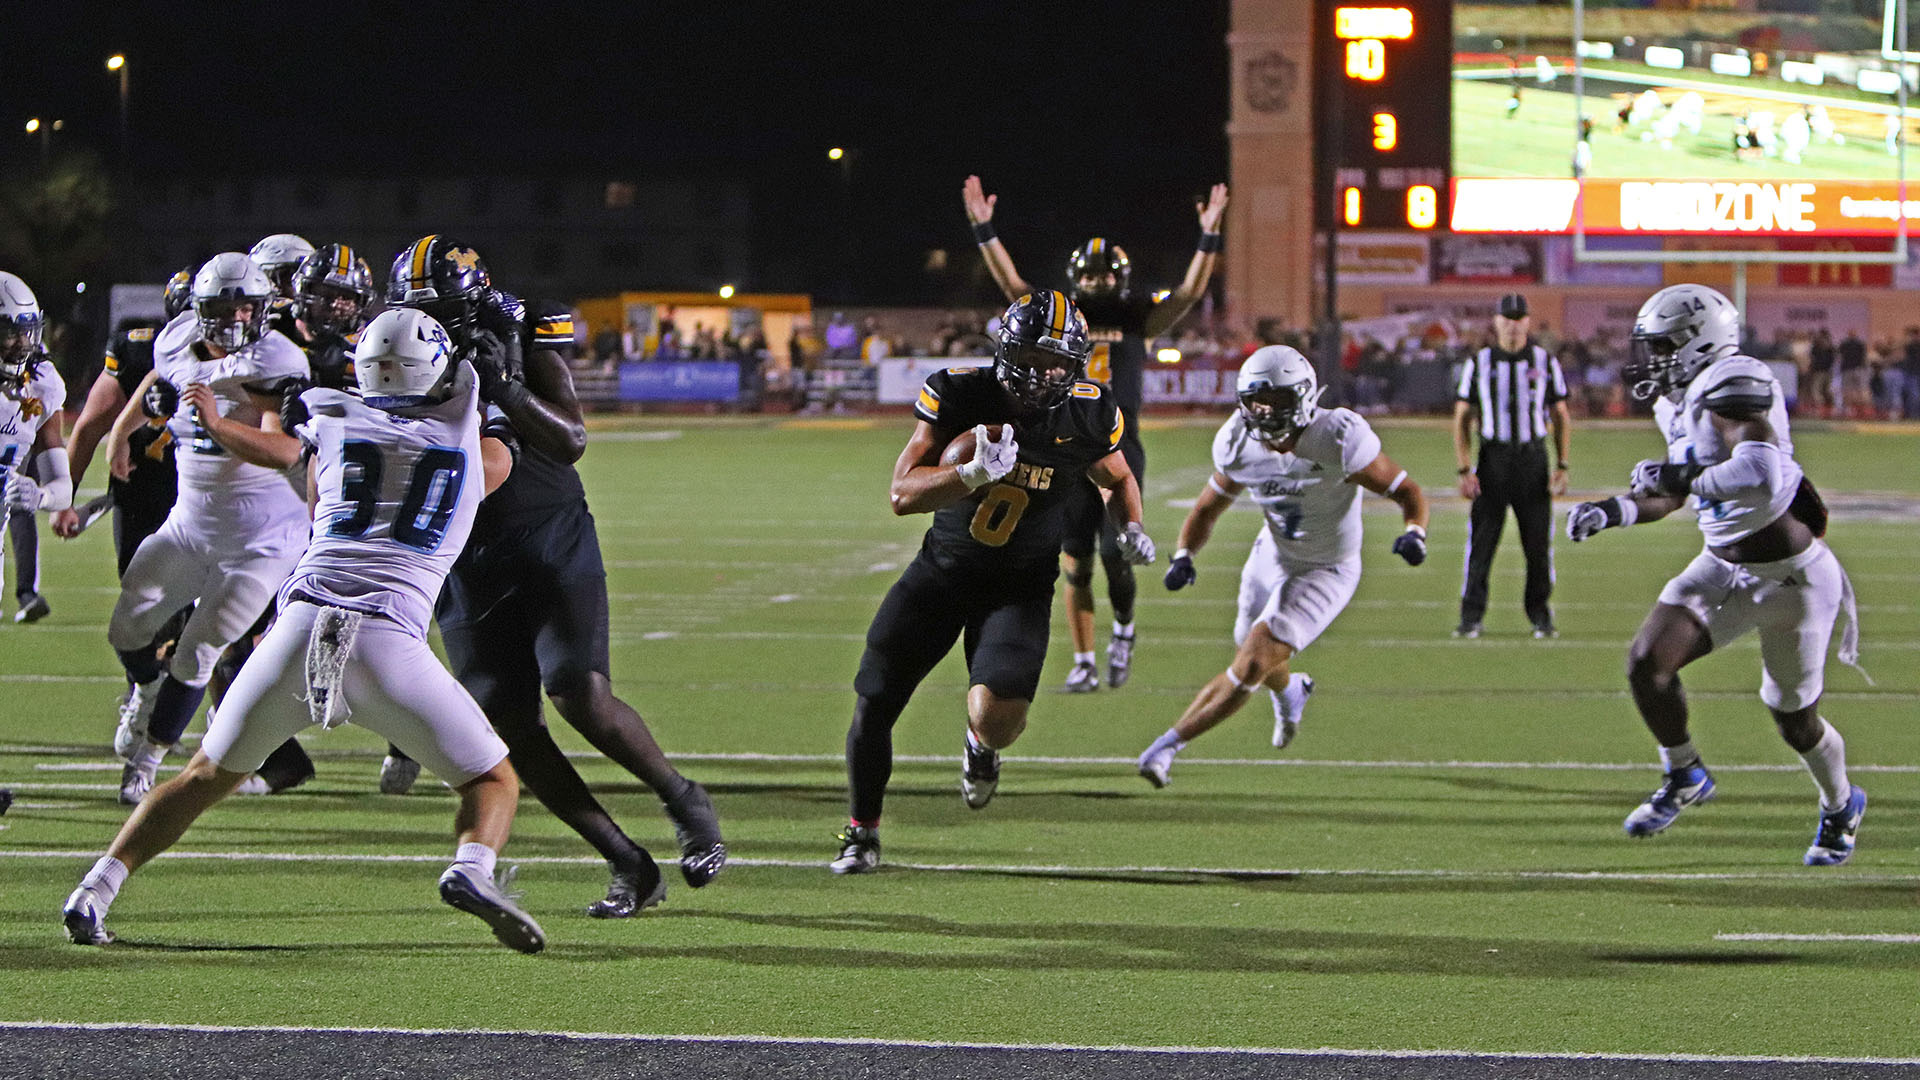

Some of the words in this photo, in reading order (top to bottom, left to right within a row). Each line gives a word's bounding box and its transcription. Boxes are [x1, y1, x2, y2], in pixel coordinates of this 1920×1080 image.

[1372, 112, 1397, 151] 3
[1344, 186, 1361, 226] 1
[1681, 296, 1706, 317] 14
[1003, 461, 1055, 490] ERS
[325, 438, 469, 555] 30
[969, 483, 1030, 547] 0
